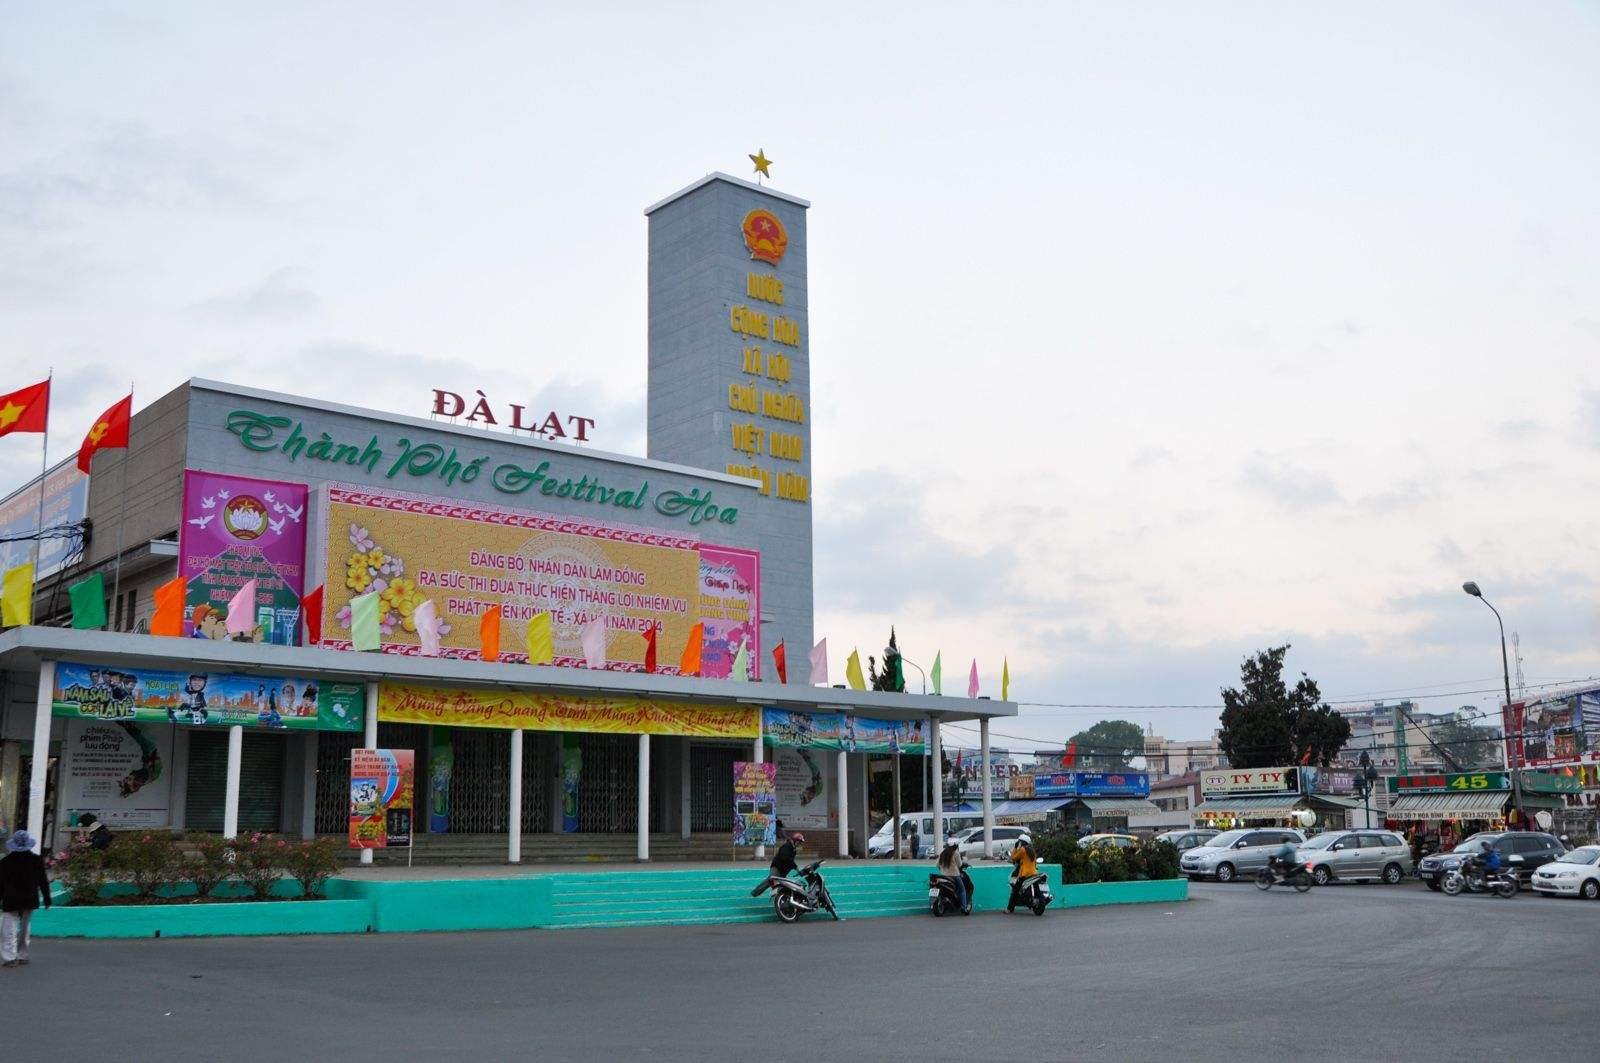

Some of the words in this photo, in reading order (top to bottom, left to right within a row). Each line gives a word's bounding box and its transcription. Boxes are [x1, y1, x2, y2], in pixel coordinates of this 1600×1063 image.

[731, 304, 768, 340] CỘNG
[432, 389, 498, 425] ĐÀ
[509, 403, 595, 441] LẠT
[729, 382, 757, 414] CHỦ
[763, 391, 805, 424] NGHĨA
[731, 423, 765, 459] VIỆT
[770, 431, 802, 462] NAM
[225, 410, 383, 474] Thành
[385, 438, 490, 487] Phố
[653, 488, 738, 525] Hoa
[471, 548, 504, 568] ĐẢNG
[529, 558, 560, 575] NHÂN
[564, 561, 586, 578] DÂN
[590, 563, 612, 581] LÂM
[615, 566, 645, 585] ĐỒNG
[420, 571, 437, 586] RA
[440, 571, 466, 589] SỨC
[468, 576, 487, 591] THI
[490, 579, 515, 595] ĐUA
[550, 584, 576, 601] HIỆN
[579, 585, 615, 605] THẮNG
[637, 594, 670, 611] NHIỆM
[672, 599, 687, 615] VỤ
[449, 598, 481, 615] PHÁT
[484, 600, 518, 619] TIỂN
[551, 606, 564, 624] TẾ
[573, 610, 588, 626] XÃ
[611, 615, 636, 631] NĂM
[498, 699, 548, 722] Quang
[1451, 775, 1488, 789] 45
